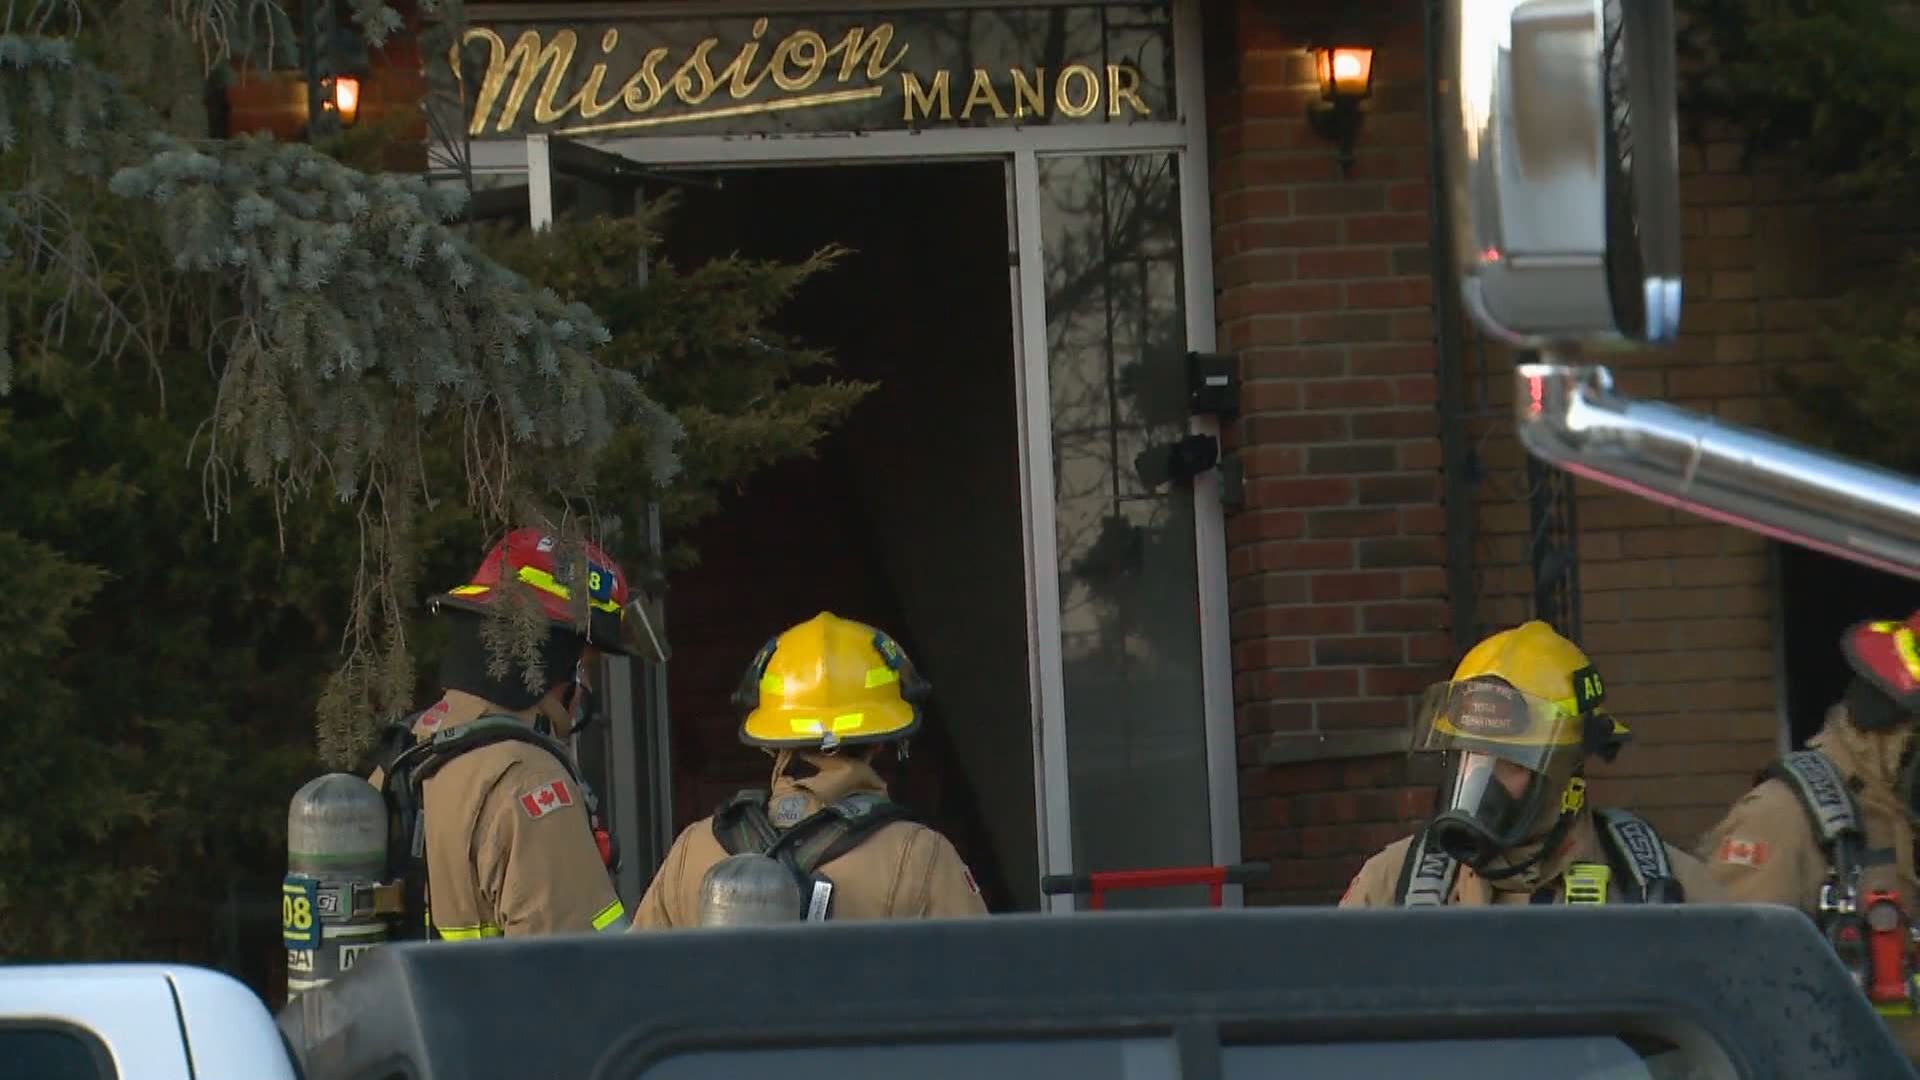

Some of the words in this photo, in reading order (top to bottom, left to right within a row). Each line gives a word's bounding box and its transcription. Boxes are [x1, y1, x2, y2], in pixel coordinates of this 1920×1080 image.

[450, 17, 909, 135] Mission
[901, 64, 1151, 121] MANOR
[589, 571, 601, 591] 8
